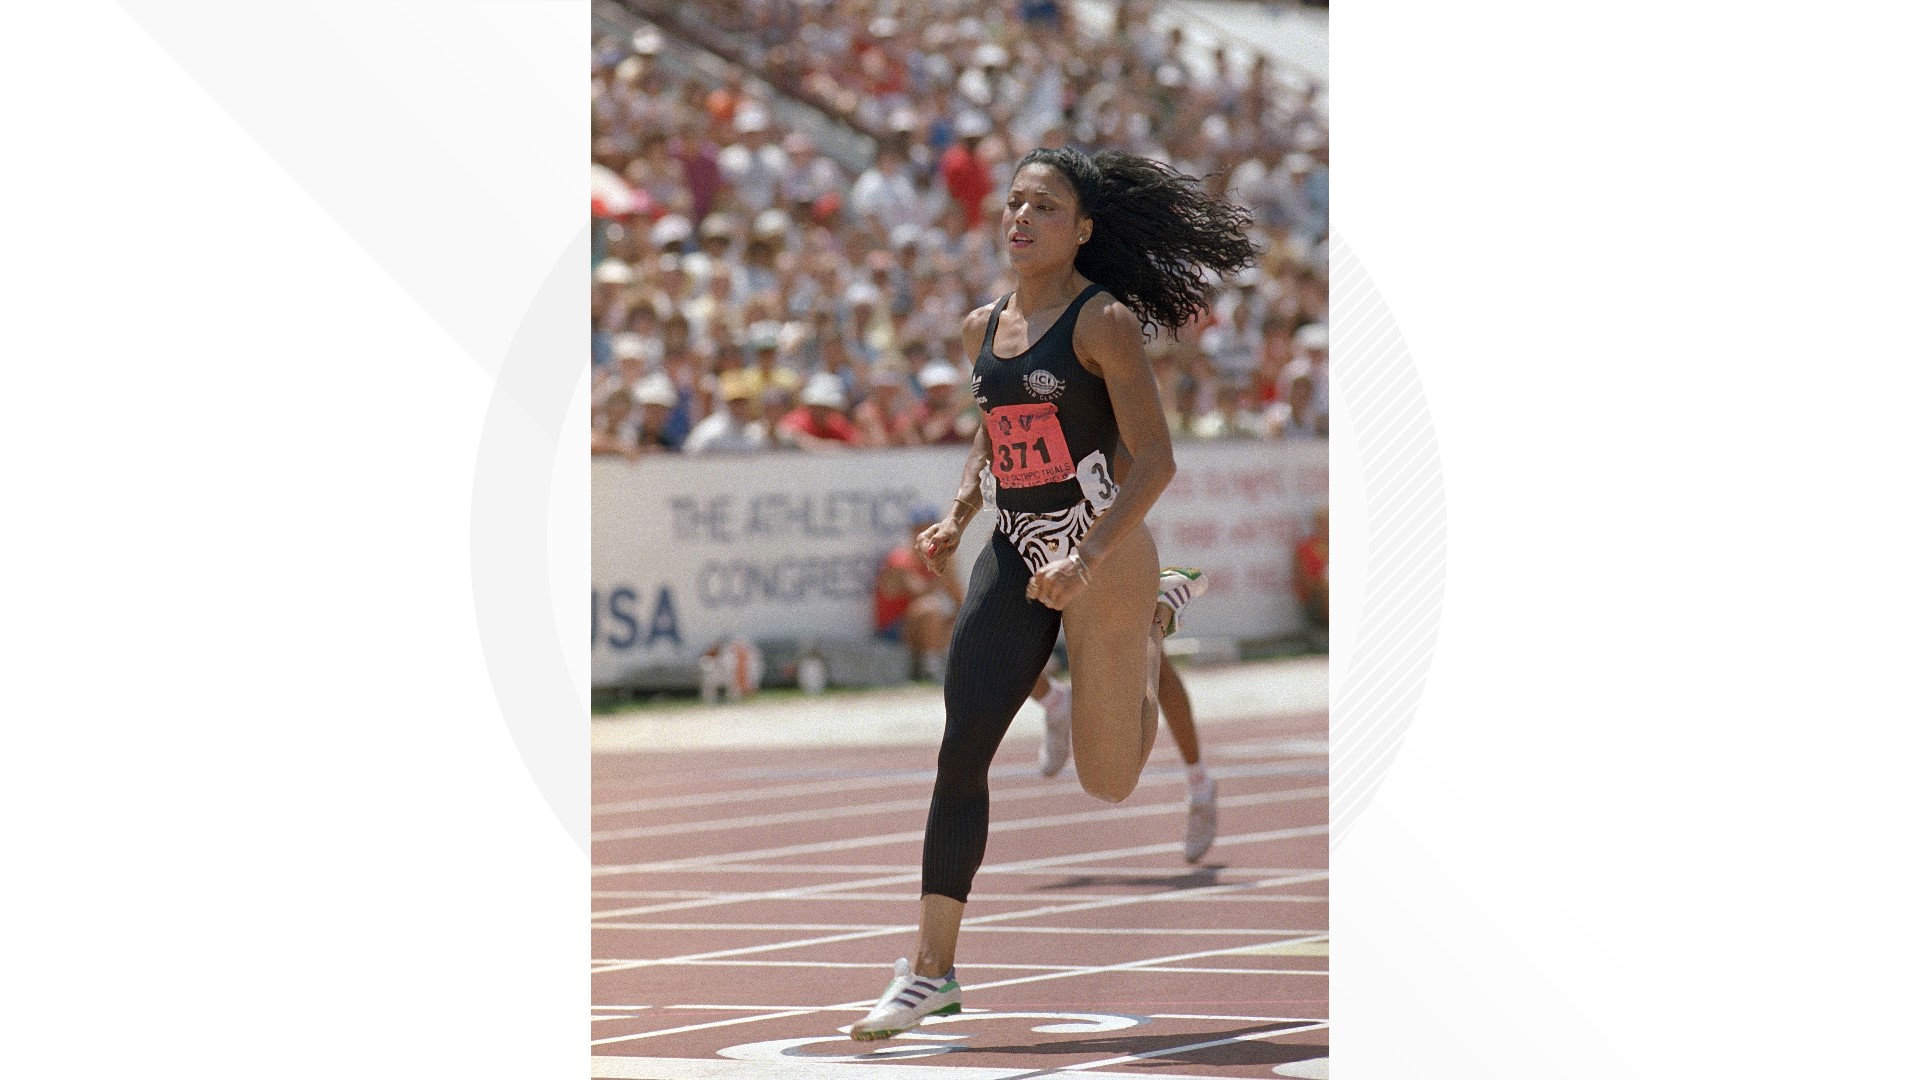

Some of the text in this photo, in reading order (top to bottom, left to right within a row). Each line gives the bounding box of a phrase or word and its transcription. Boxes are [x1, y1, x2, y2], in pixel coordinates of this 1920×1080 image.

[1033, 373, 1052, 386] ICI
[998, 436, 1052, 473] 371
[1011, 470, 1042, 482] OLYMPIC
[1041, 462, 1072, 477] TRIALS
[1090, 462, 1112, 500] 3
[669, 486, 917, 543] THE ATHLETICS
[698, 554, 874, 608] CONGRES
